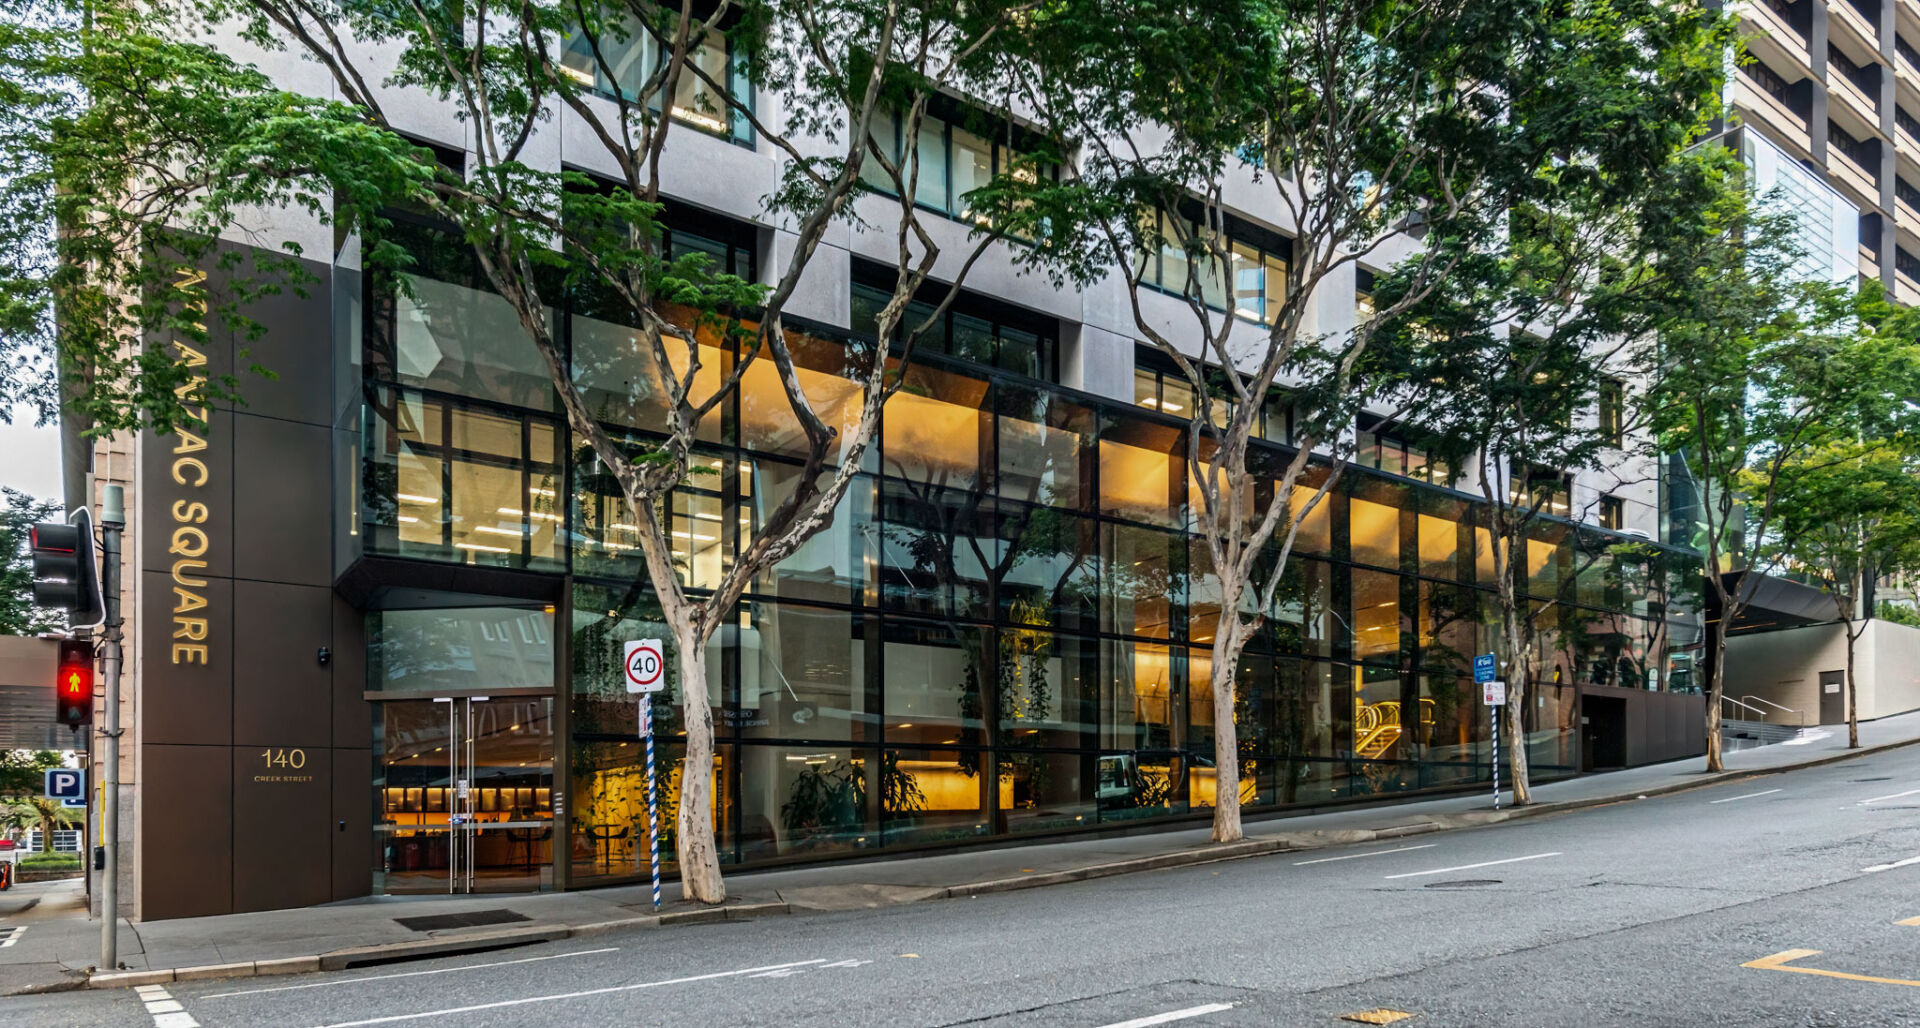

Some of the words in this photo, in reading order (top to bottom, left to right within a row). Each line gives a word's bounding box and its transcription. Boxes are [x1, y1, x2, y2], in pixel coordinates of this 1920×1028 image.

[169, 499, 208, 665] SQUARE
[632, 657, 656, 674] 40
[261, 749, 305, 768] 140
[56, 774, 75, 794] P
